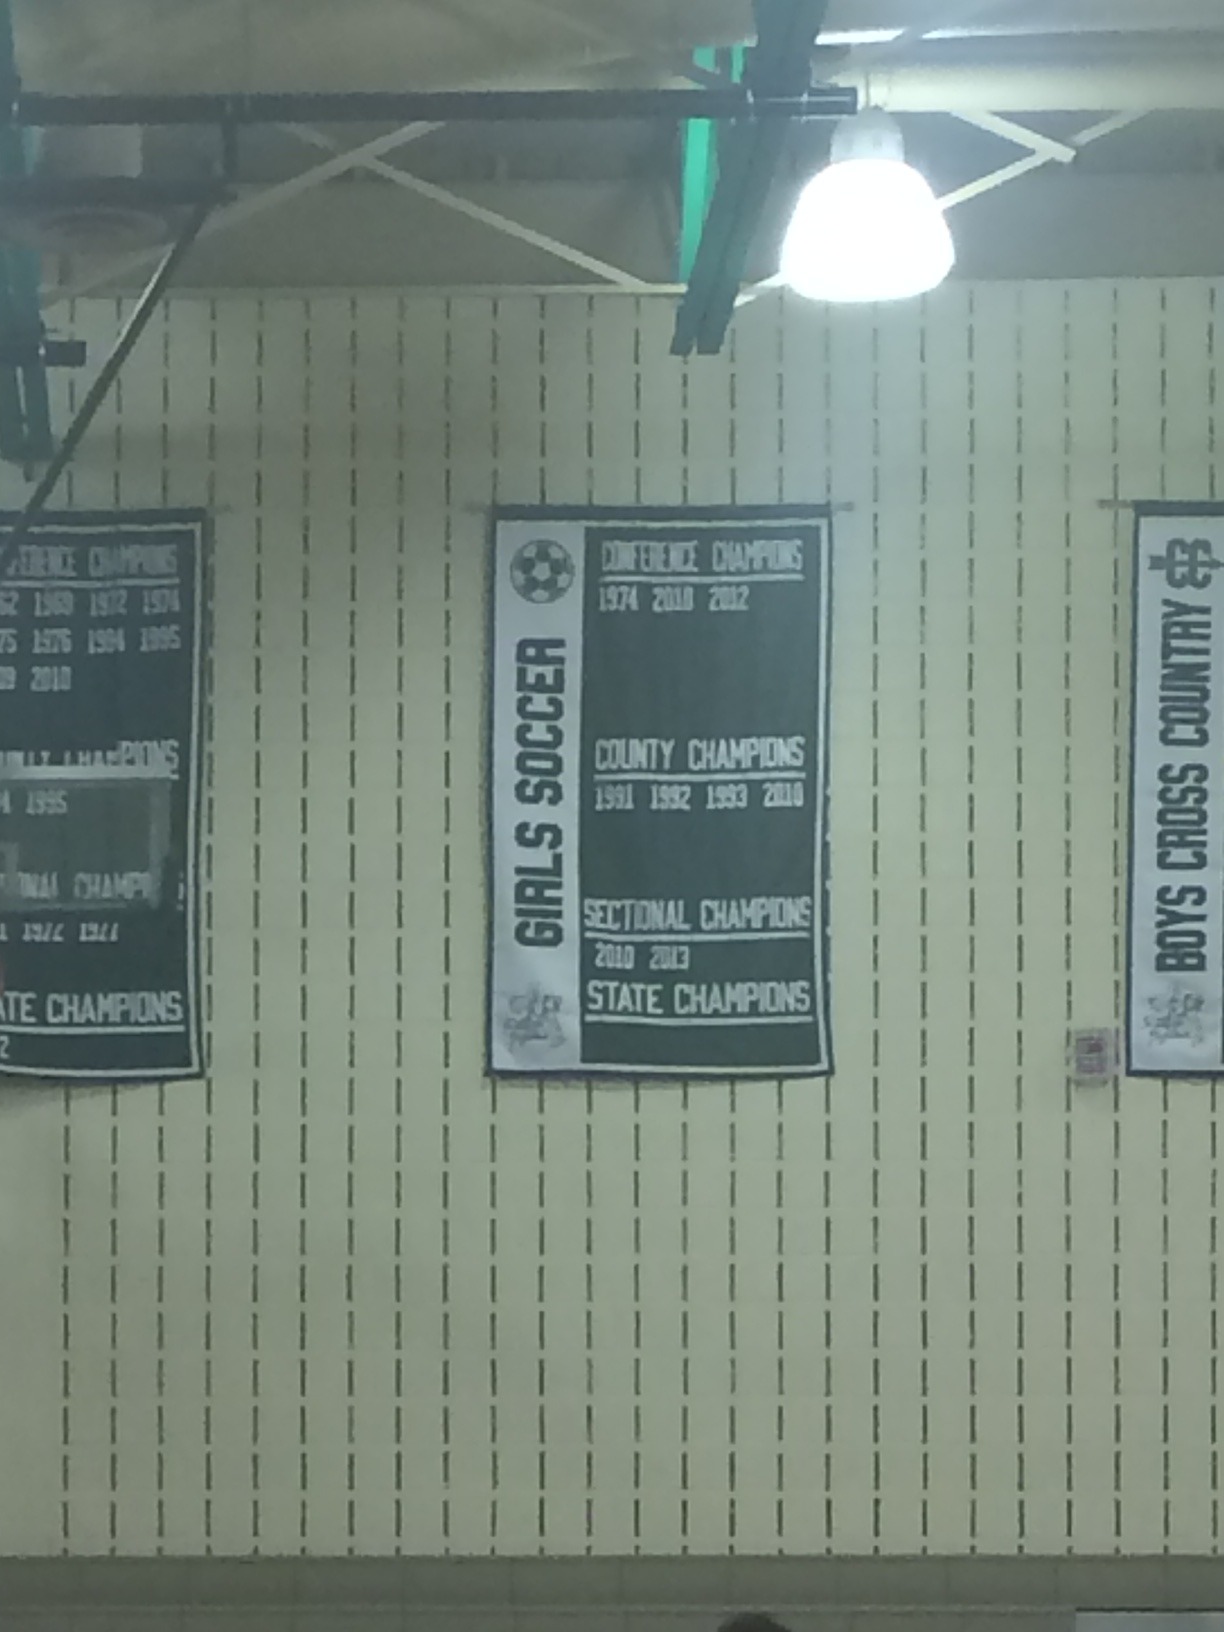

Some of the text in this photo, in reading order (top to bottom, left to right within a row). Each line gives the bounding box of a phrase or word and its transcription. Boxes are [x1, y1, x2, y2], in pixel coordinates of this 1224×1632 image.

[595, 736, 805, 771] COUNTY CHAMPIONS
[514, 637, 567, 947] GIRLS SOCCER
[1154, 598, 1212, 972] BOYS CROSS COUNTRY
[584, 896, 811, 931] SECTIONAL CHAMPIONS
[46, 991, 184, 1024] CHAMPIONS
[587, 980, 811, 1015] STATE CHAMPIONS
